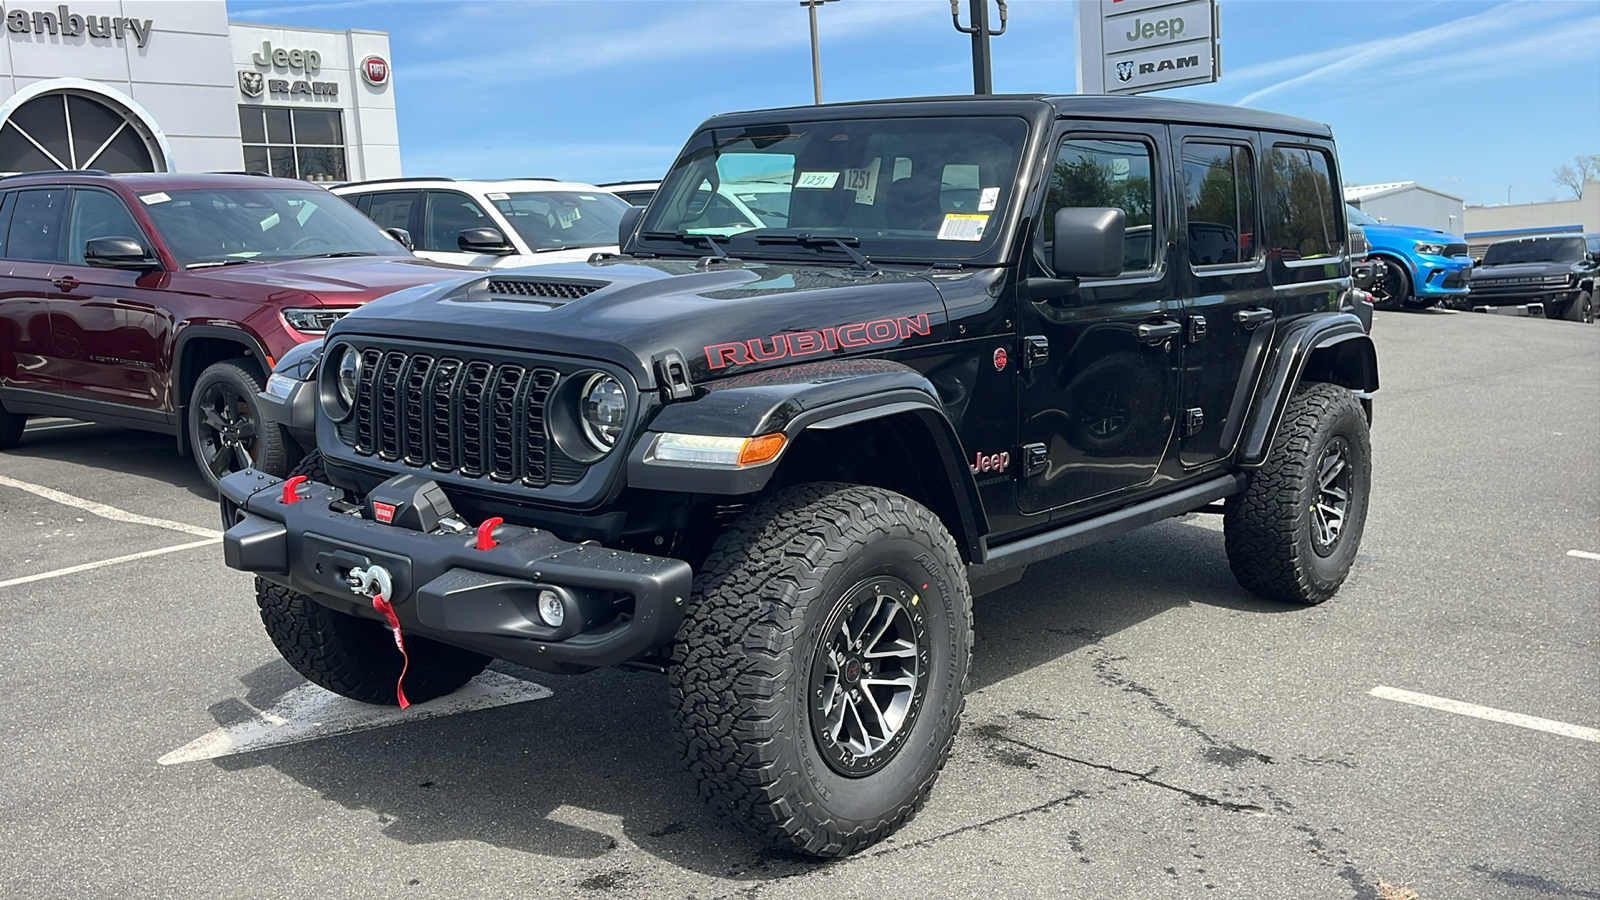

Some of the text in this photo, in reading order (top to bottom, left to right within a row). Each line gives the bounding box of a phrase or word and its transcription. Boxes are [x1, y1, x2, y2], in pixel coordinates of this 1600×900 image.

[0, 4, 153, 48] anbury
[1126, 17, 1184, 42] Jeep
[252, 41, 321, 73] Jeep
[1139, 56, 1198, 75] RAM
[369, 62, 385, 76] FIAT
[268, 79, 339, 95] RAM
[802, 175, 828, 186] 1251
[847, 169, 871, 191] 1251
[703, 313, 931, 370] RUBICON
[969, 451, 1010, 475] Jeep
